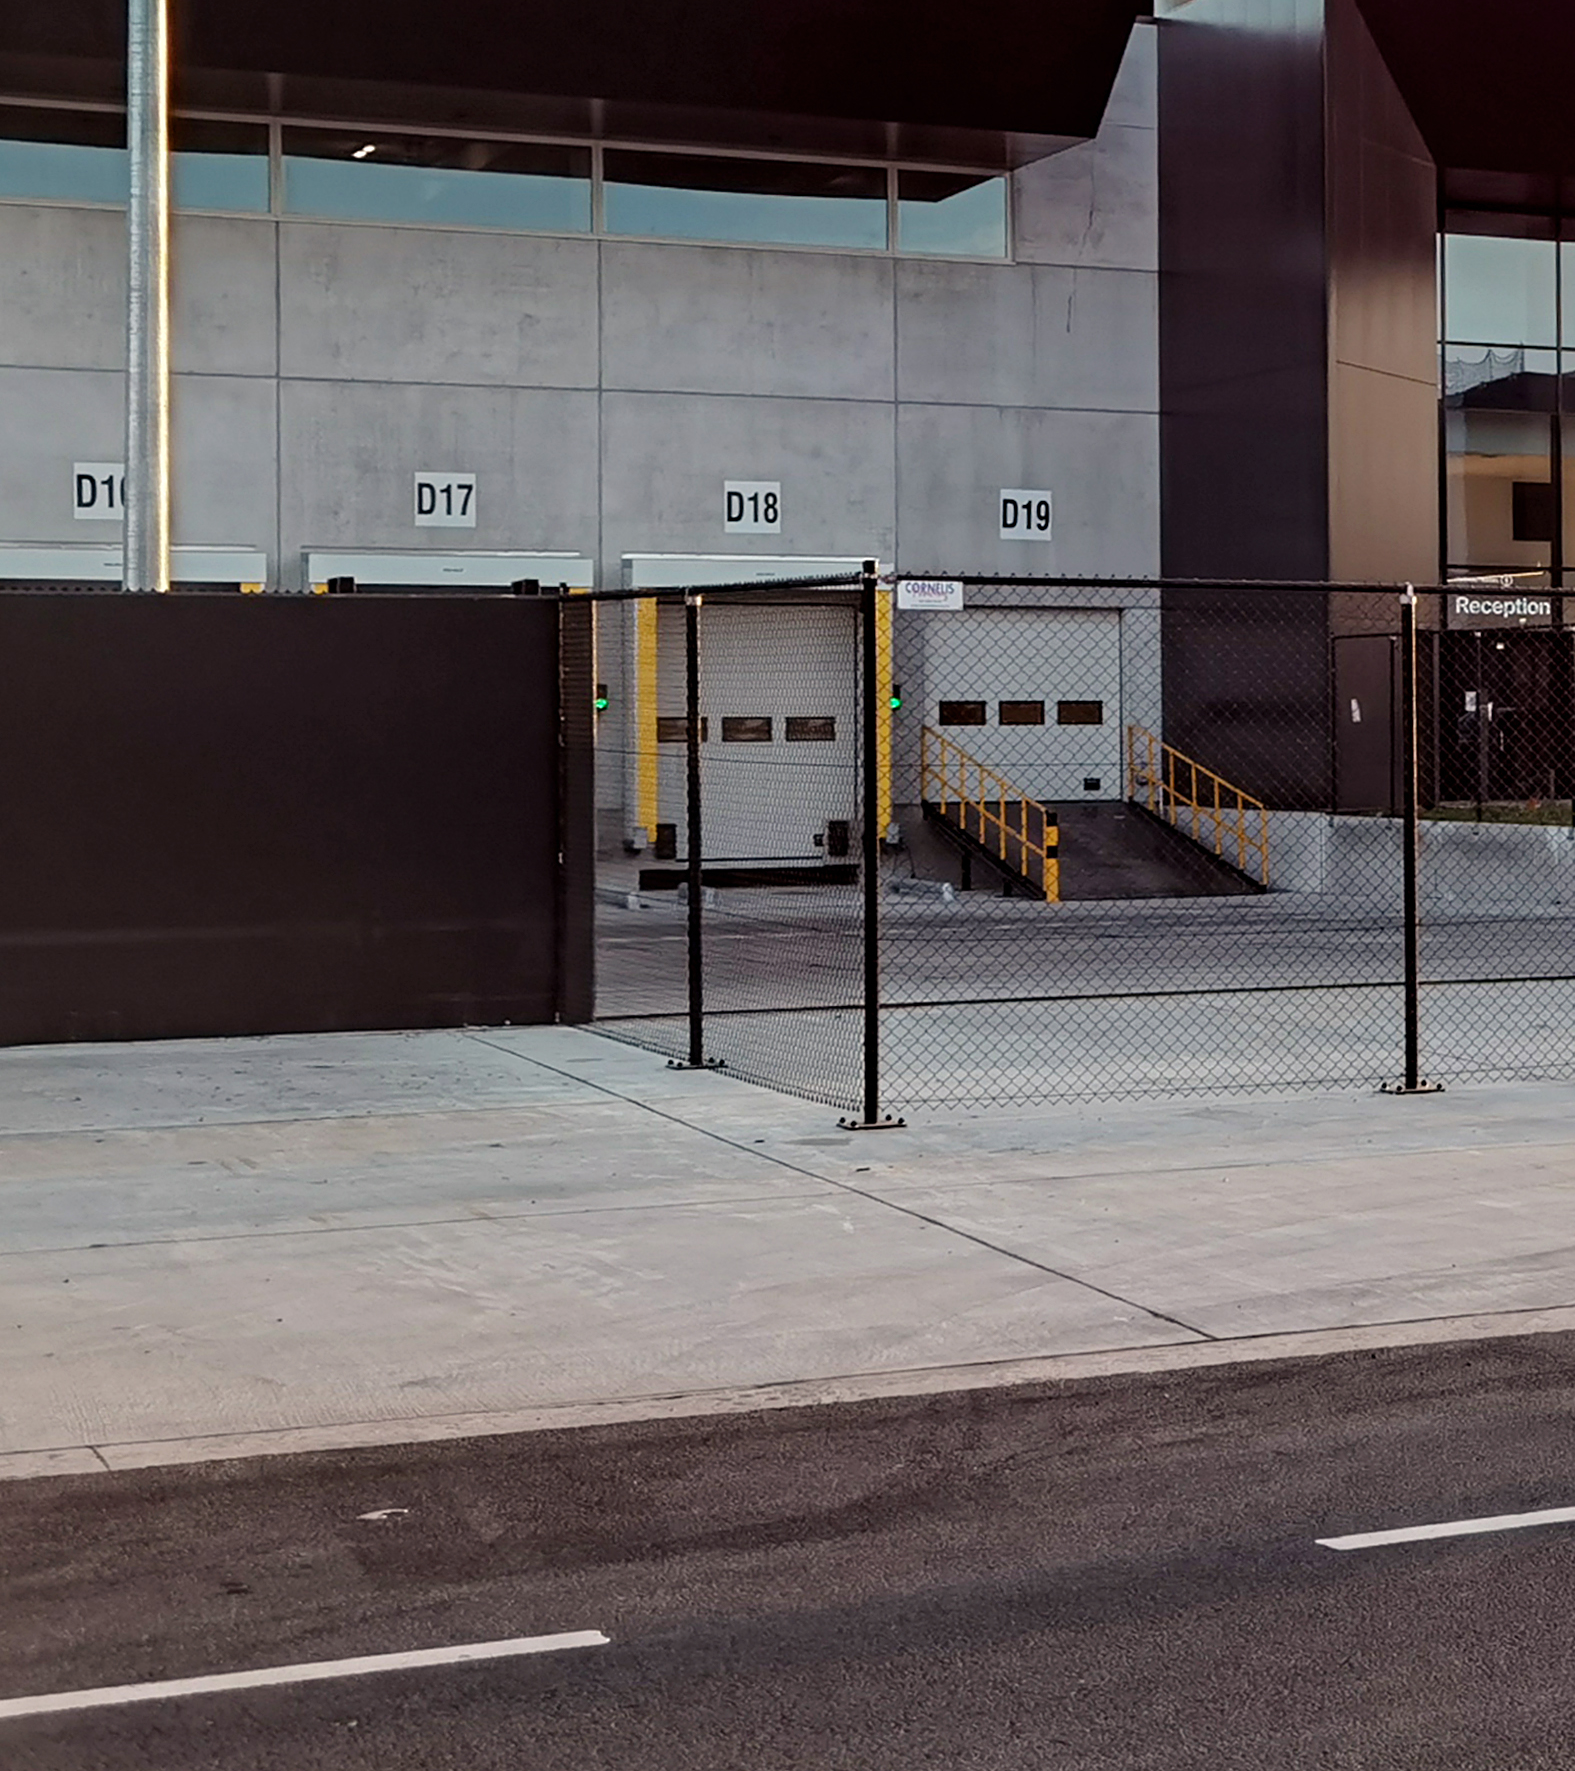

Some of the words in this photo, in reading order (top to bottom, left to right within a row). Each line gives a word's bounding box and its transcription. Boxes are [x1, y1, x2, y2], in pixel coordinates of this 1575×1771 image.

[76, 473, 125, 508] D1
[417, 482, 474, 516] D17
[726, 491, 779, 524] D18
[1002, 498, 1050, 531] D19
[1455, 596, 1551, 618] Reception
